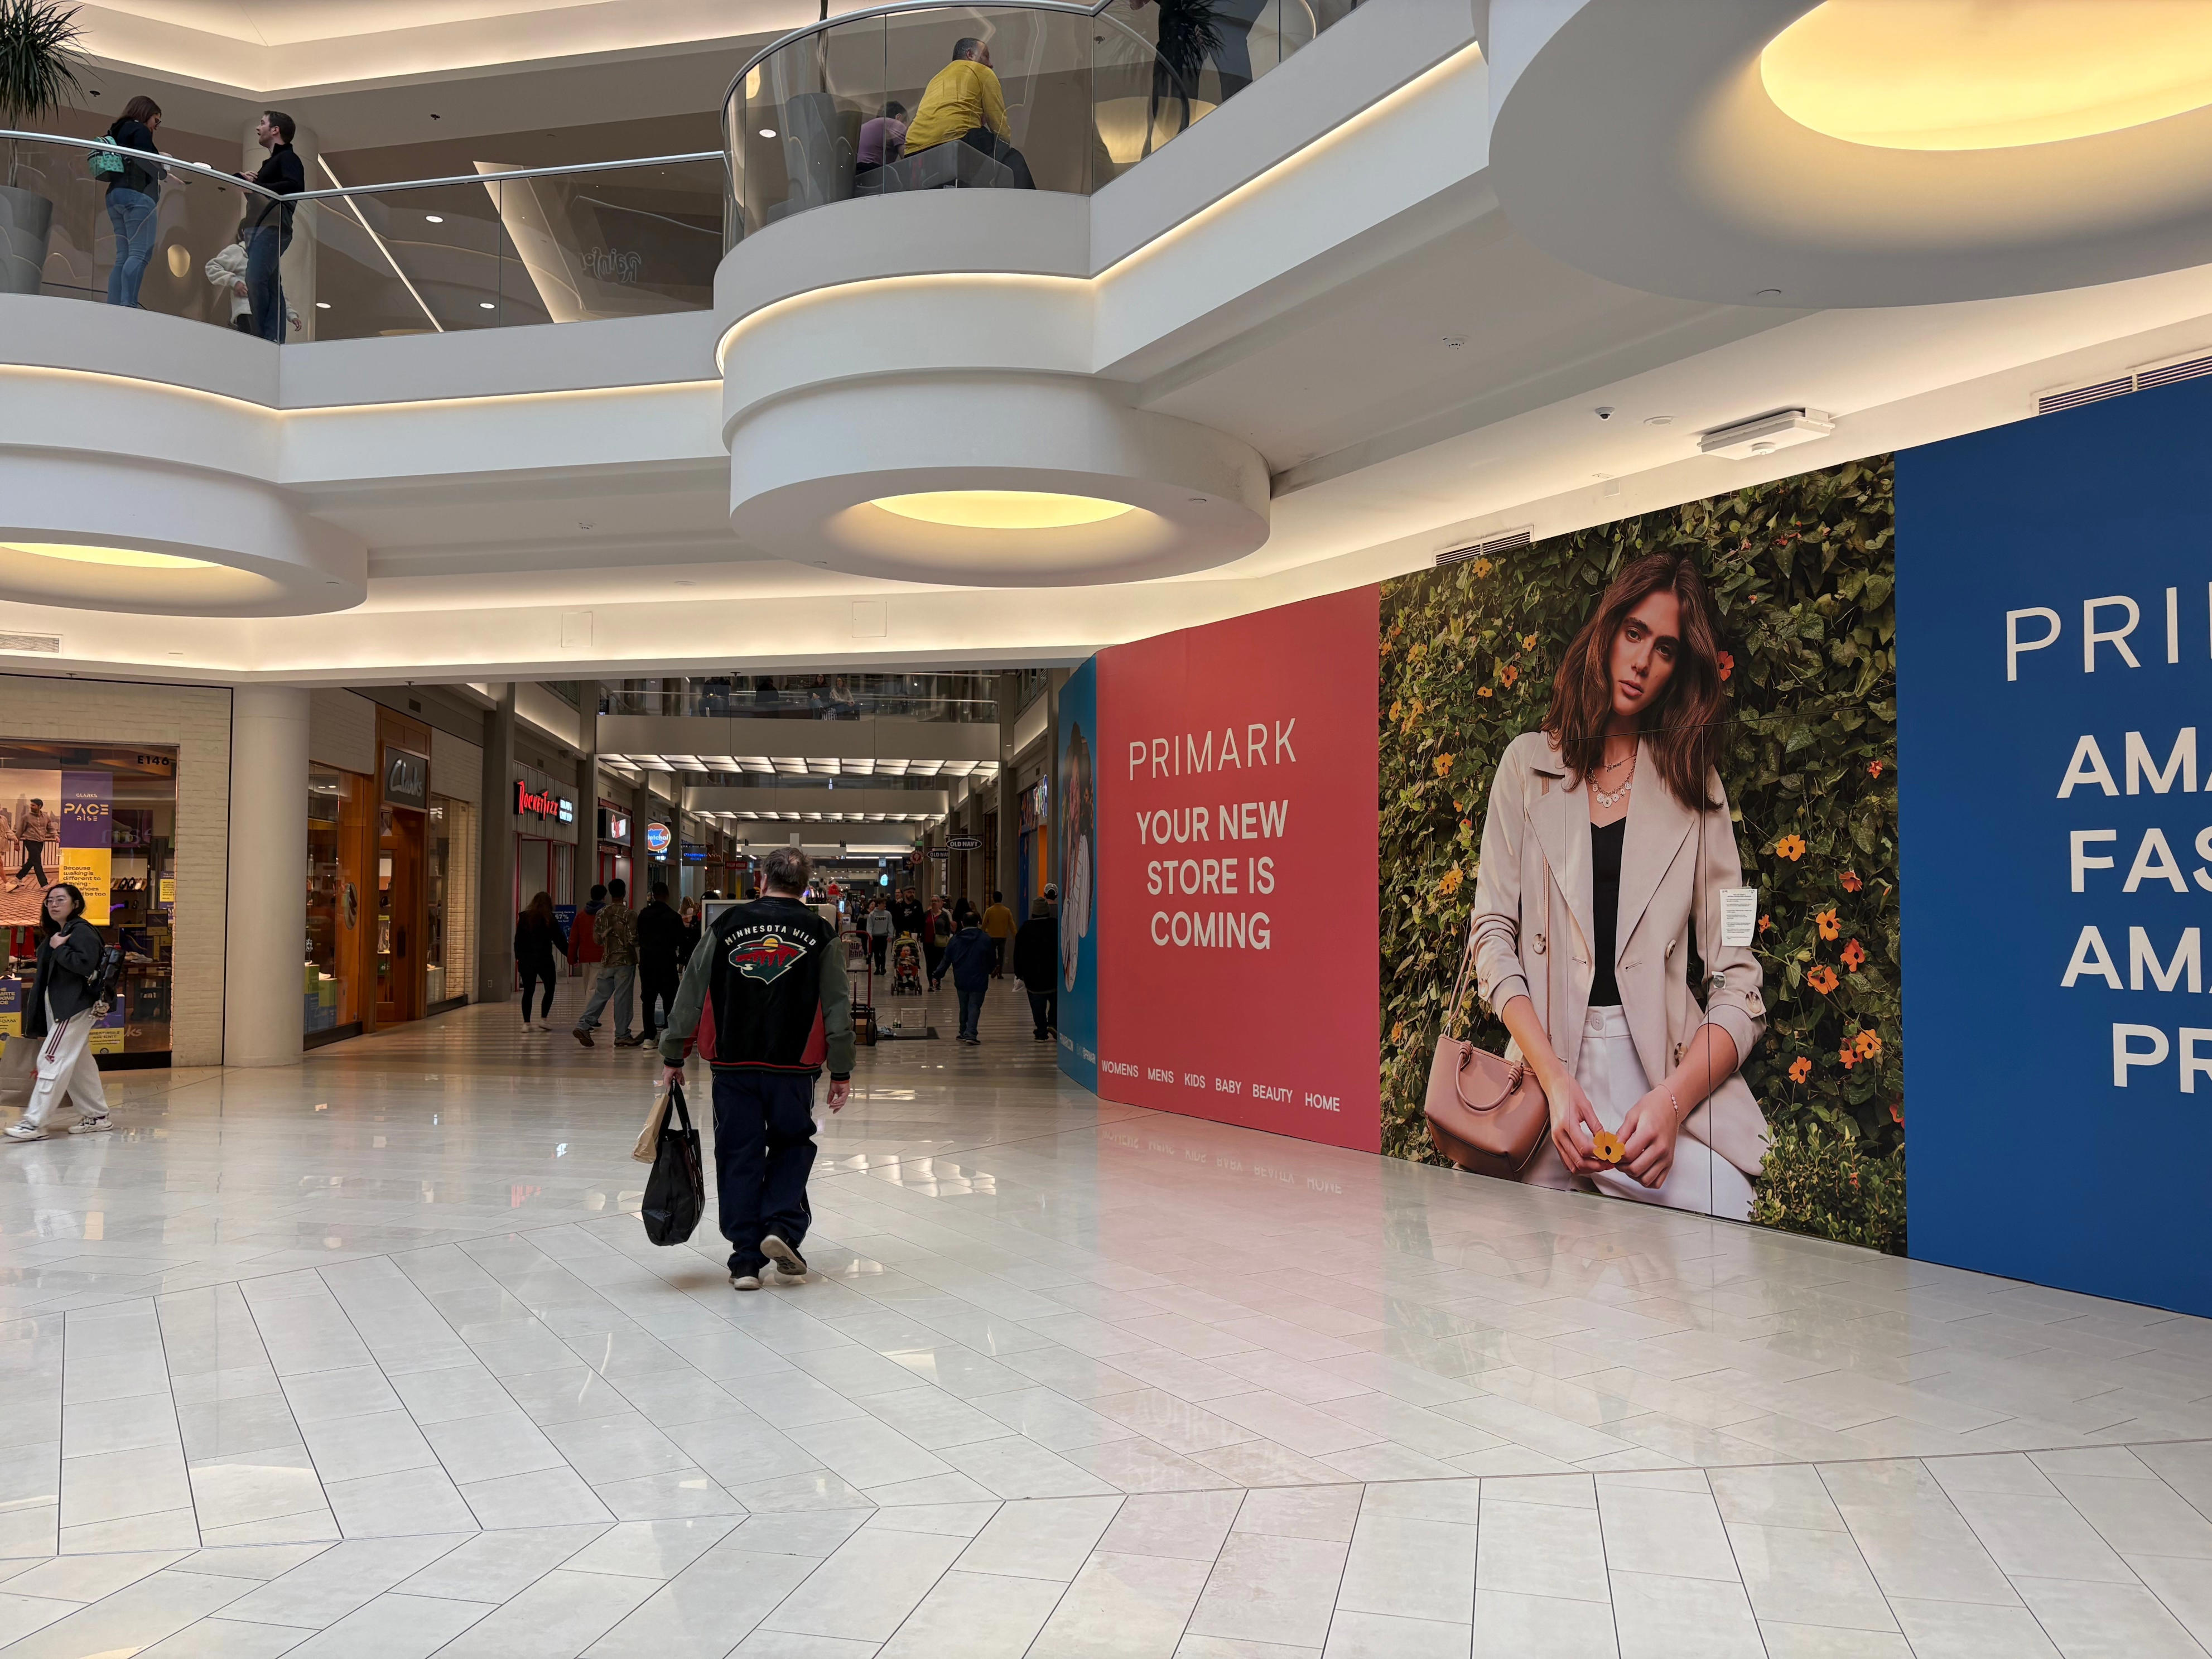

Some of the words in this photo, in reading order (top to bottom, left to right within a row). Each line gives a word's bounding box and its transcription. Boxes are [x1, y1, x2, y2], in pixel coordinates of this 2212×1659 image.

[2006, 581, 2212, 682] PRI
[137, 755, 170, 765] E146
[1130, 718, 1297, 781] PRIMARK
[2056, 727, 2212, 799] AM
[64, 803, 109, 815] PACE
[1136, 807, 1209, 845] YOUR
[1219, 799, 1289, 841] NEW
[1147, 858, 1238, 895] STORE
[1249, 856, 1275, 894] IS
[725, 925, 787, 946] MINNESOTA
[793, 928, 817, 946] WILD
[1151, 911, 1270, 950] COMING
[2060, 925, 2212, 994] AM
[1101, 1060, 1139, 1078] WOMENS
[1148, 1067, 1174, 1083] MENS
[1184, 1073, 1206, 1088] KIDS
[1215, 1078, 1242, 1094] BABY
[1252, 1084, 1293, 1103] BEAUTY
[1305, 1092, 1340, 1112] HOME
